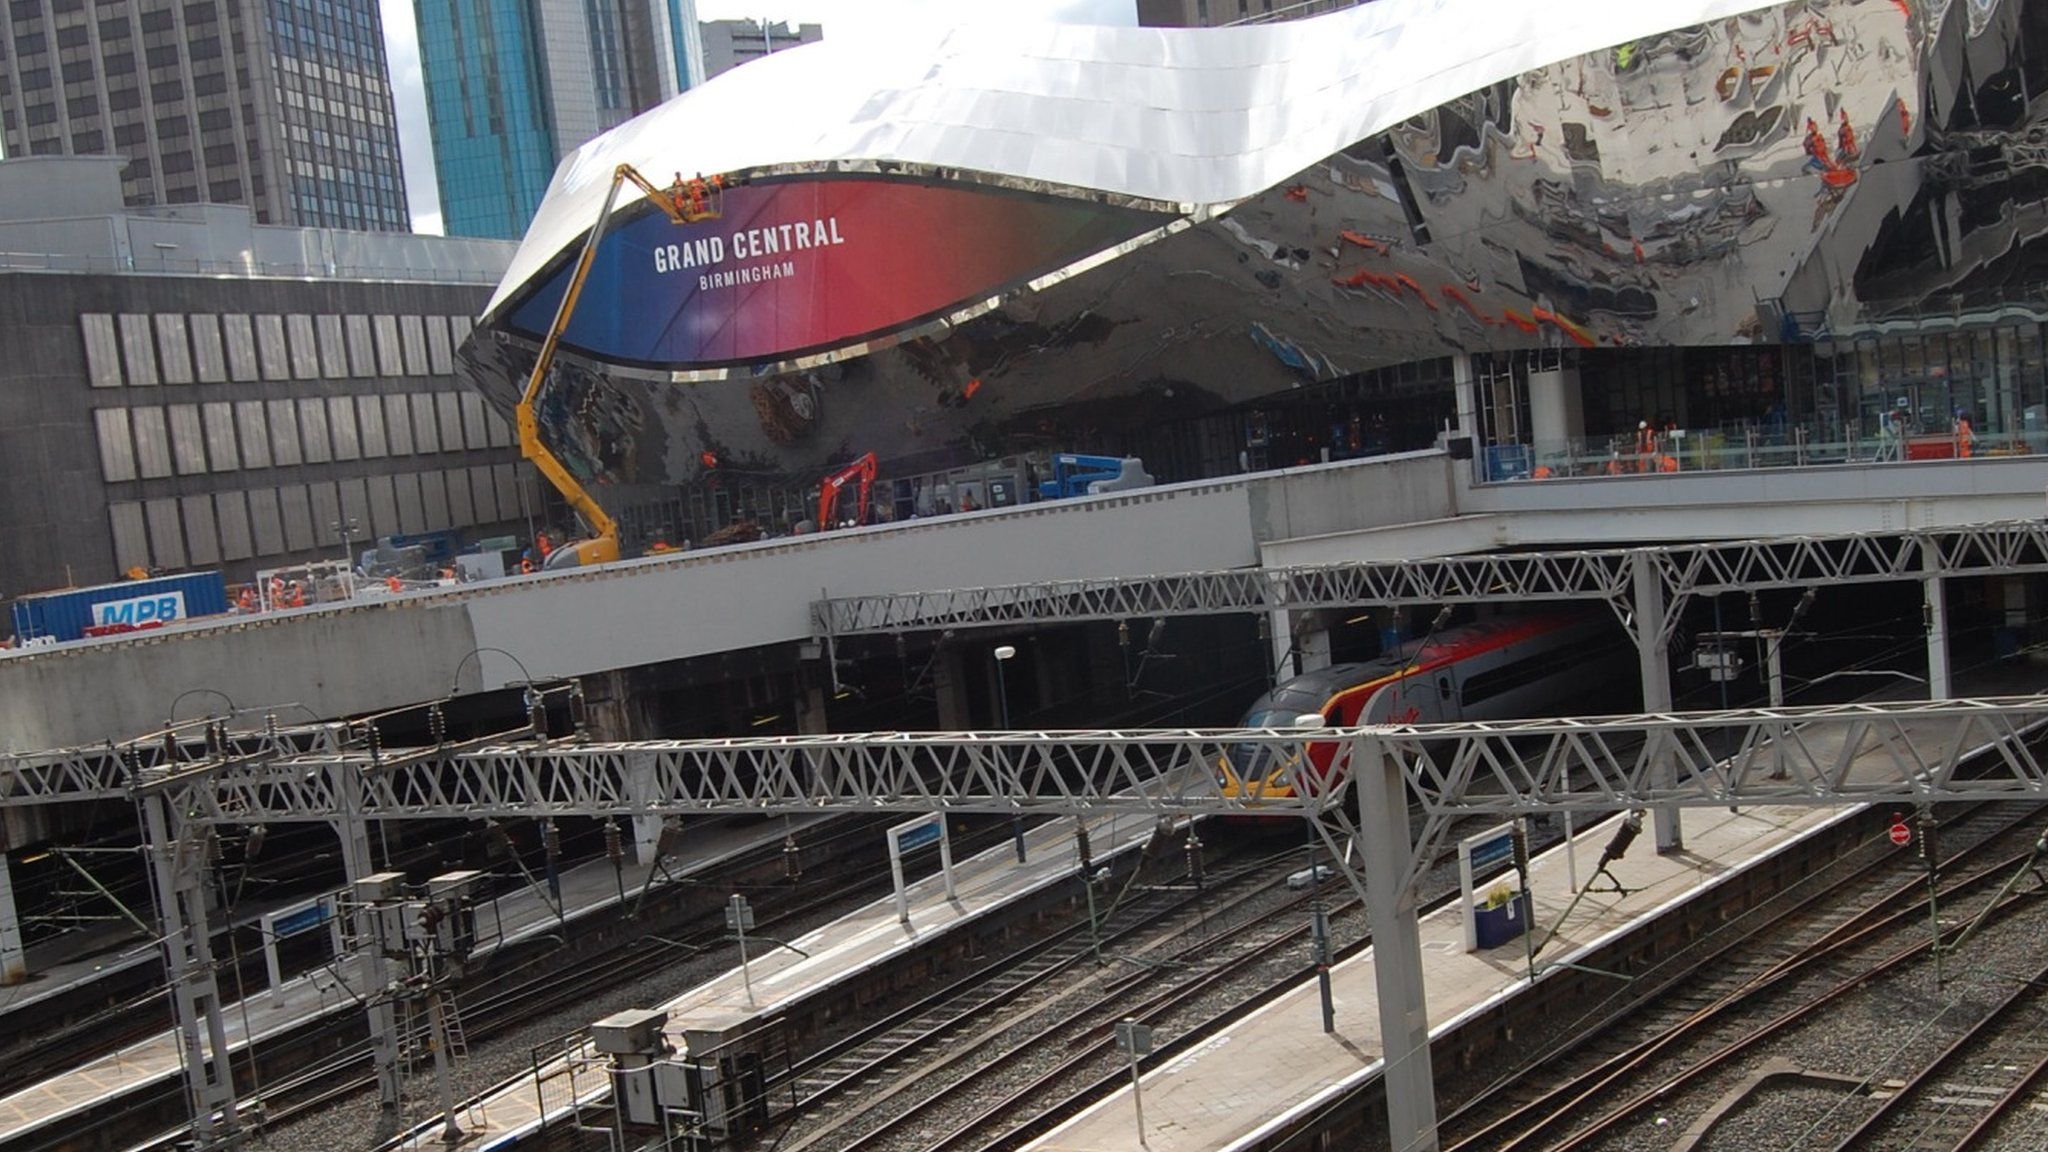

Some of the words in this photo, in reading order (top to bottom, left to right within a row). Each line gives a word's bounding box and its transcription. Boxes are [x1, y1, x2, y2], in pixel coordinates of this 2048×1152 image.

[654, 236, 724, 273] GRAND
[733, 217, 844, 259] CENTRAL
[699, 261, 794, 290] BIRMINGHAM
[102, 597, 177, 626] MPB
